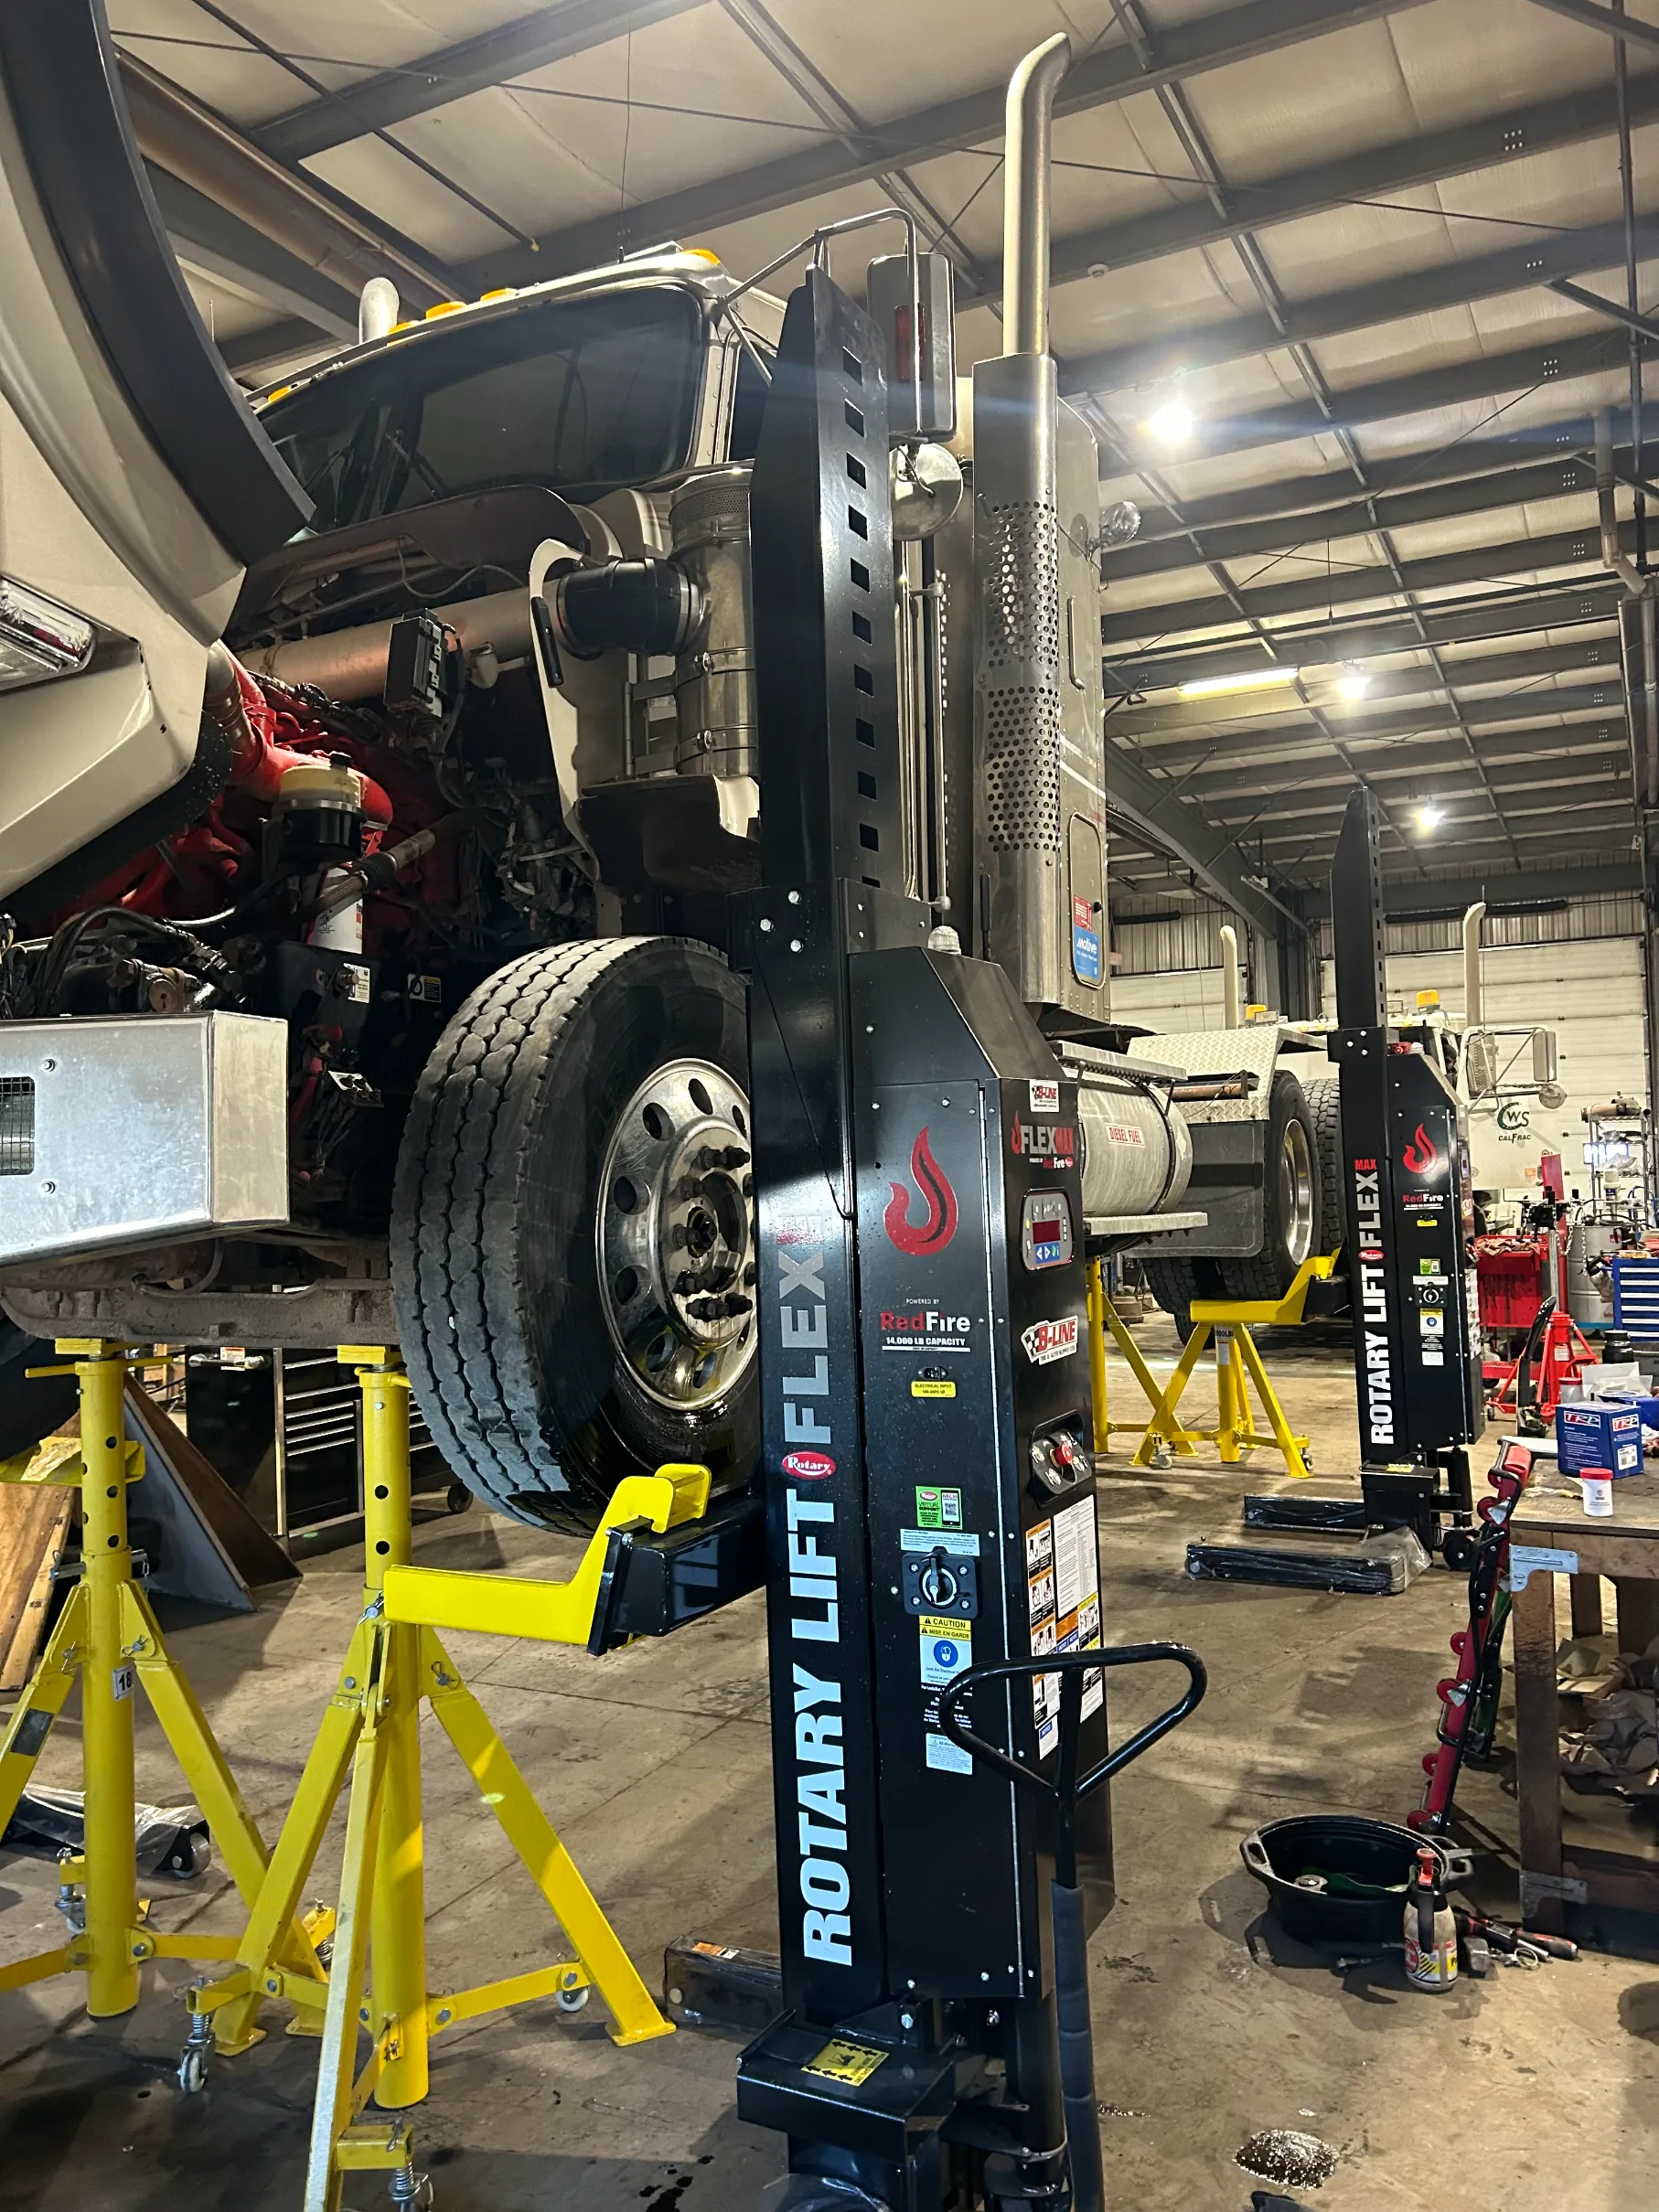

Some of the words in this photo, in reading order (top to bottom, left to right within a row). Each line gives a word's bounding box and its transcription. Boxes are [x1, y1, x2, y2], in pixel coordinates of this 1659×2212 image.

[1109, 1127, 1128, 1141] DIESEL
[1129, 1130, 1141, 1143] FUEL
[1354, 1159, 1376, 1170] MAX
[1403, 1193, 1443, 1202] RedFire
[1355, 1171, 1382, 1247] FLEX
[1361, 1265, 1387, 1322] LIFT
[880, 1310, 971, 1332] RedFire
[886, 1337, 913, 1345] 14,000
[926, 1338, 966, 1346] CAPACITY
[1038, 1320, 1076, 1352] B-LINE
[777, 1248, 831, 1445] FLEX
[1365, 1330, 1395, 1445] ROTARY
[1566, 1414, 1600, 1425] TRP
[1615, 1416, 1638, 1429] TRP
[787, 1457, 831, 1476] Rotary
[786, 1489, 840, 1643] LIFT
[933, 1619, 966, 1628] CAUTION
[793, 1662, 852, 1967] ROTARY
